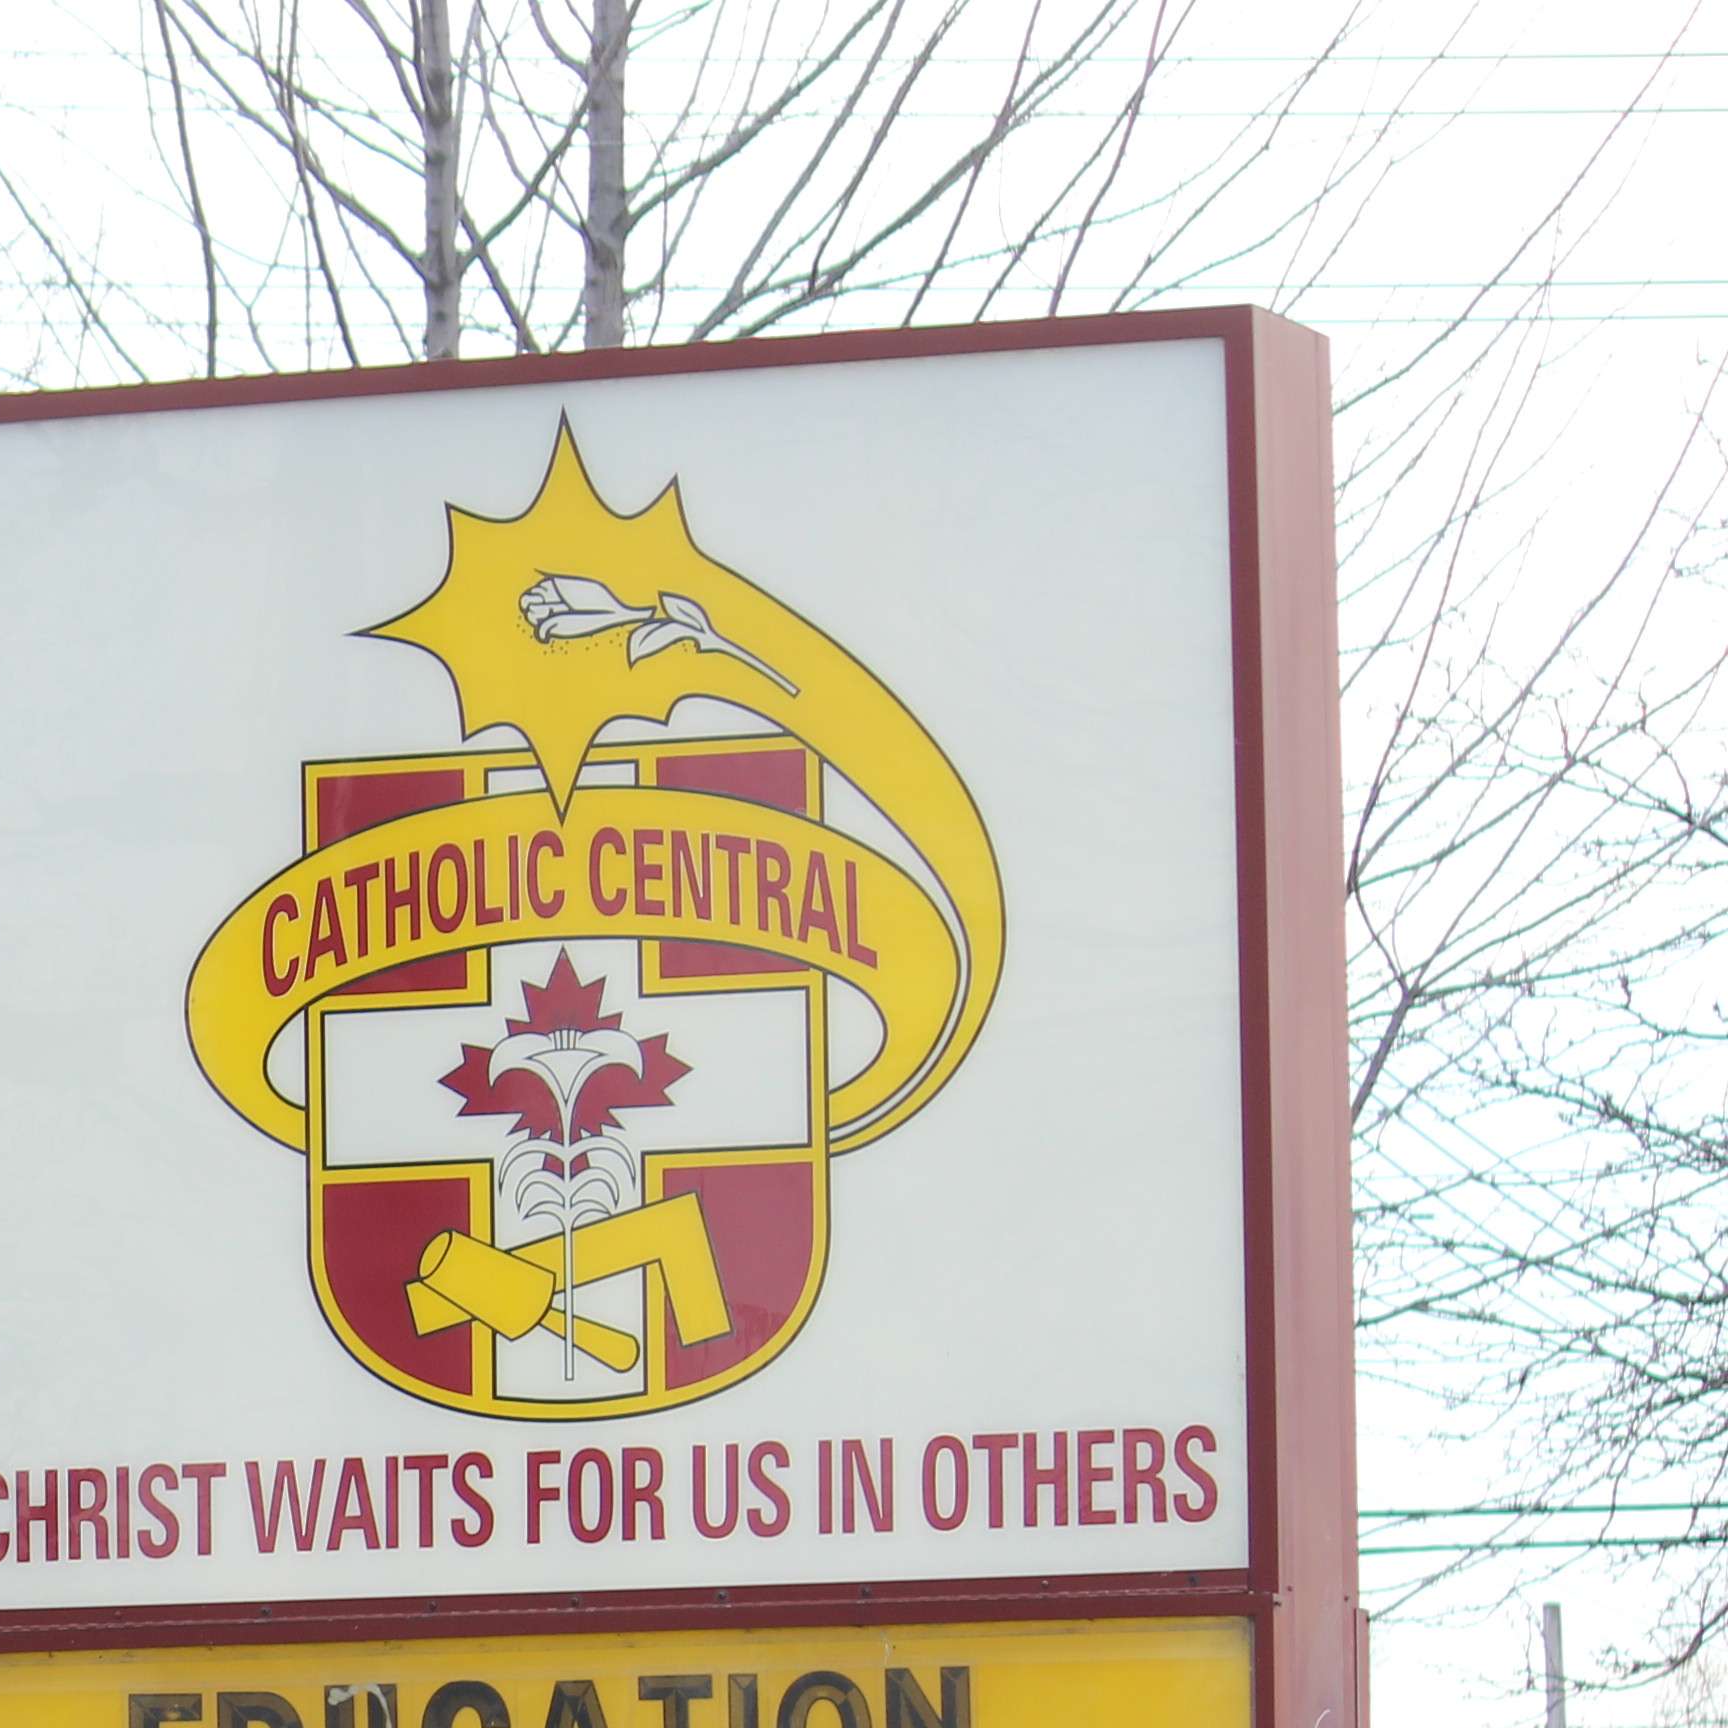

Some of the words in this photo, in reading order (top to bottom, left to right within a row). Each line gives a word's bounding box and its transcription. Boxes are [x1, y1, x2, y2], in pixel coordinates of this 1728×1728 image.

[262, 830, 565, 998] CATHOLIC
[589, 827, 877, 968] CENTRAL
[246, 1451, 494, 1553] WAITS
[526, 1447, 665, 1545] FOR
[692, 1441, 791, 1539] US
[818, 1438, 893, 1535] IN
[922, 1425, 1218, 1531] OTHERS
